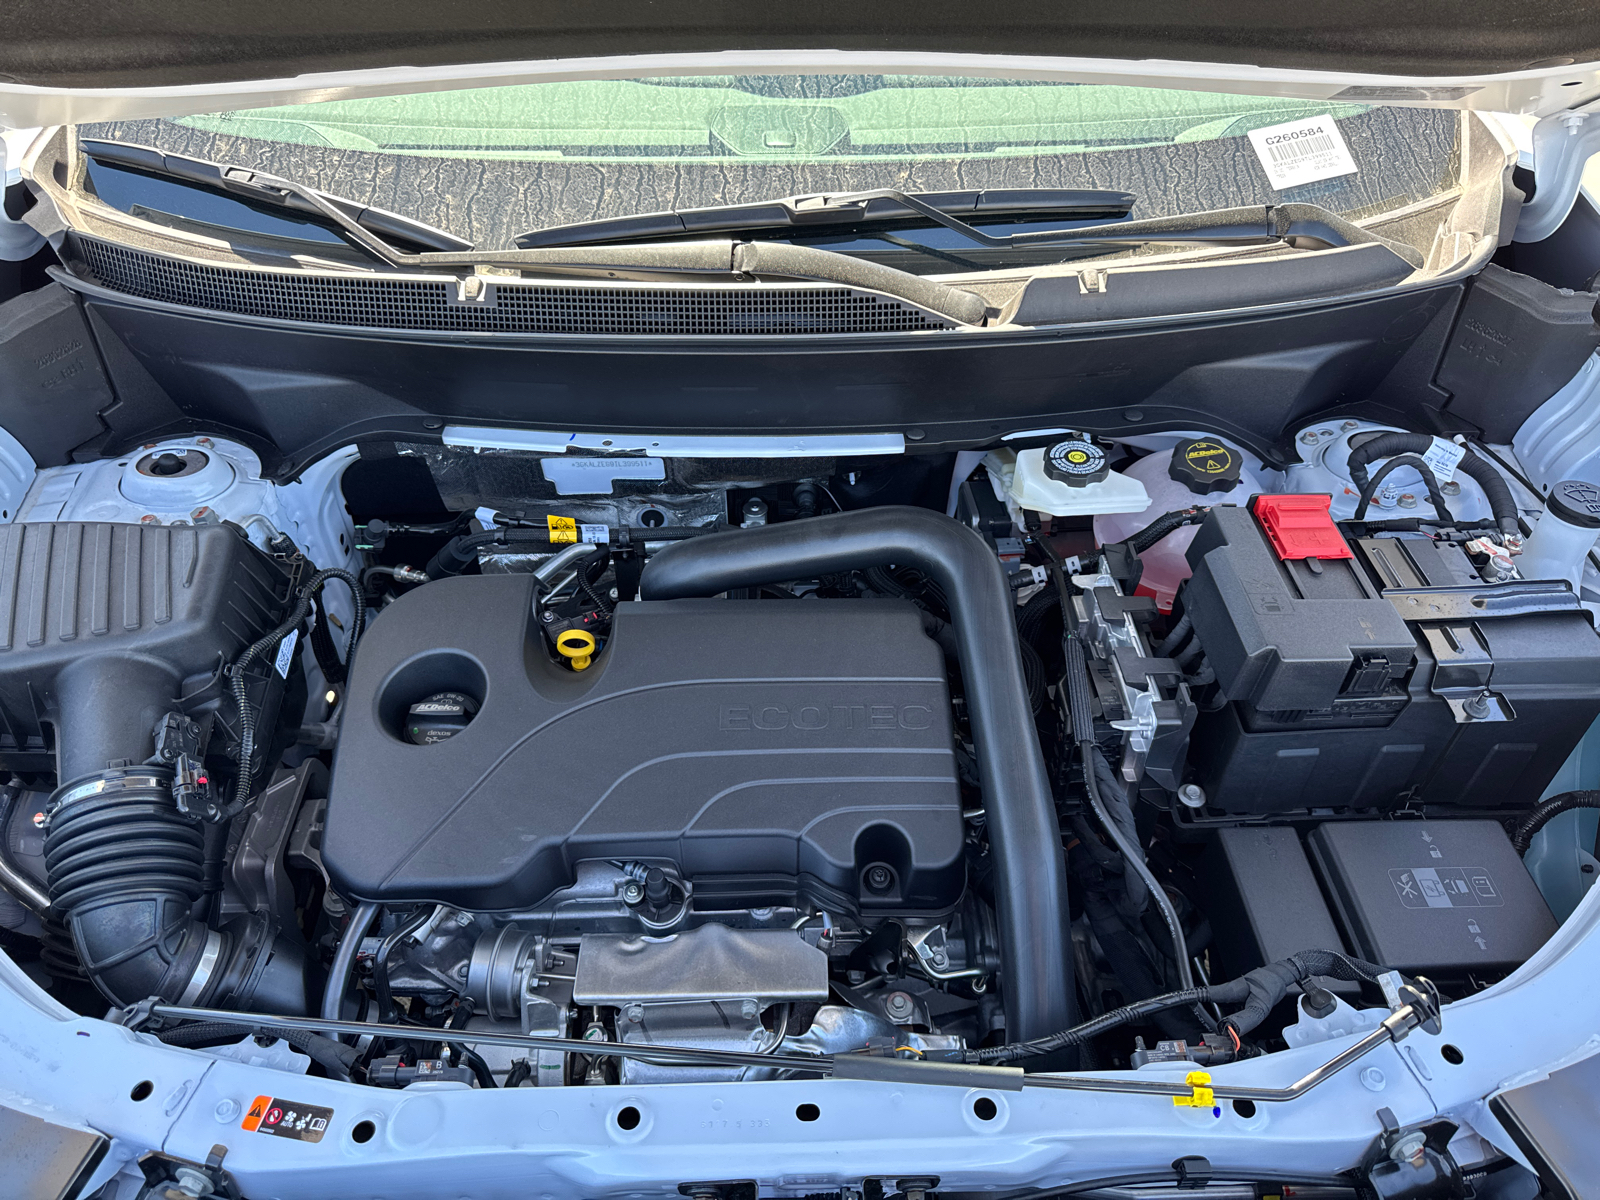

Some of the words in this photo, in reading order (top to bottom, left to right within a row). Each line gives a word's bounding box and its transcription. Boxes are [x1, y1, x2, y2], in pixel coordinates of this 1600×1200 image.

[1265, 126, 1324, 145] G260584
[415, 703, 460, 712] ACDelco
[718, 703, 933, 730] ECOTEC
[435, 1060, 443, 1069] B
